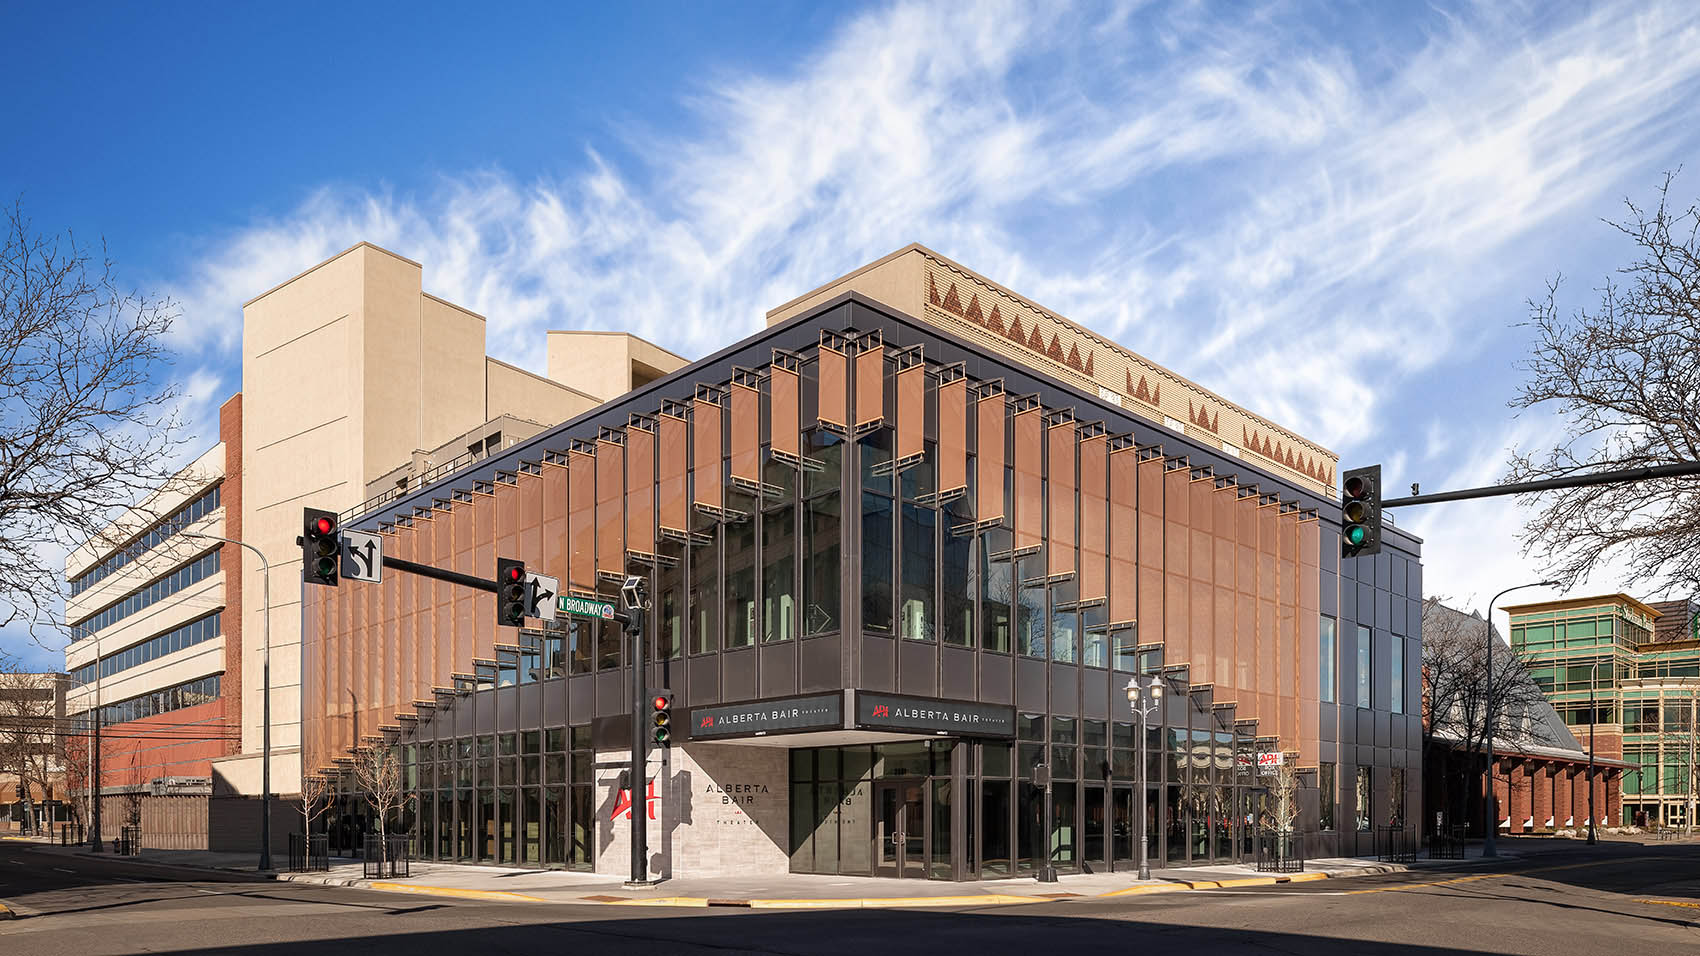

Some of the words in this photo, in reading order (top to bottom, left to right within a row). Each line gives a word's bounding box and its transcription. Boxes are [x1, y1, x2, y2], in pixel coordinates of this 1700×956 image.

[559, 597, 565, 609] N
[566, 598, 602, 616] BROADWAY
[718, 712, 768, 726] ALBERTA
[772, 708, 799, 720] BAIR
[895, 708, 949, 721] ALBERTA
[953, 713, 980, 723] BAIR
[705, 784, 769, 794] ALBERTA
[722, 795, 754, 805] BAIR
